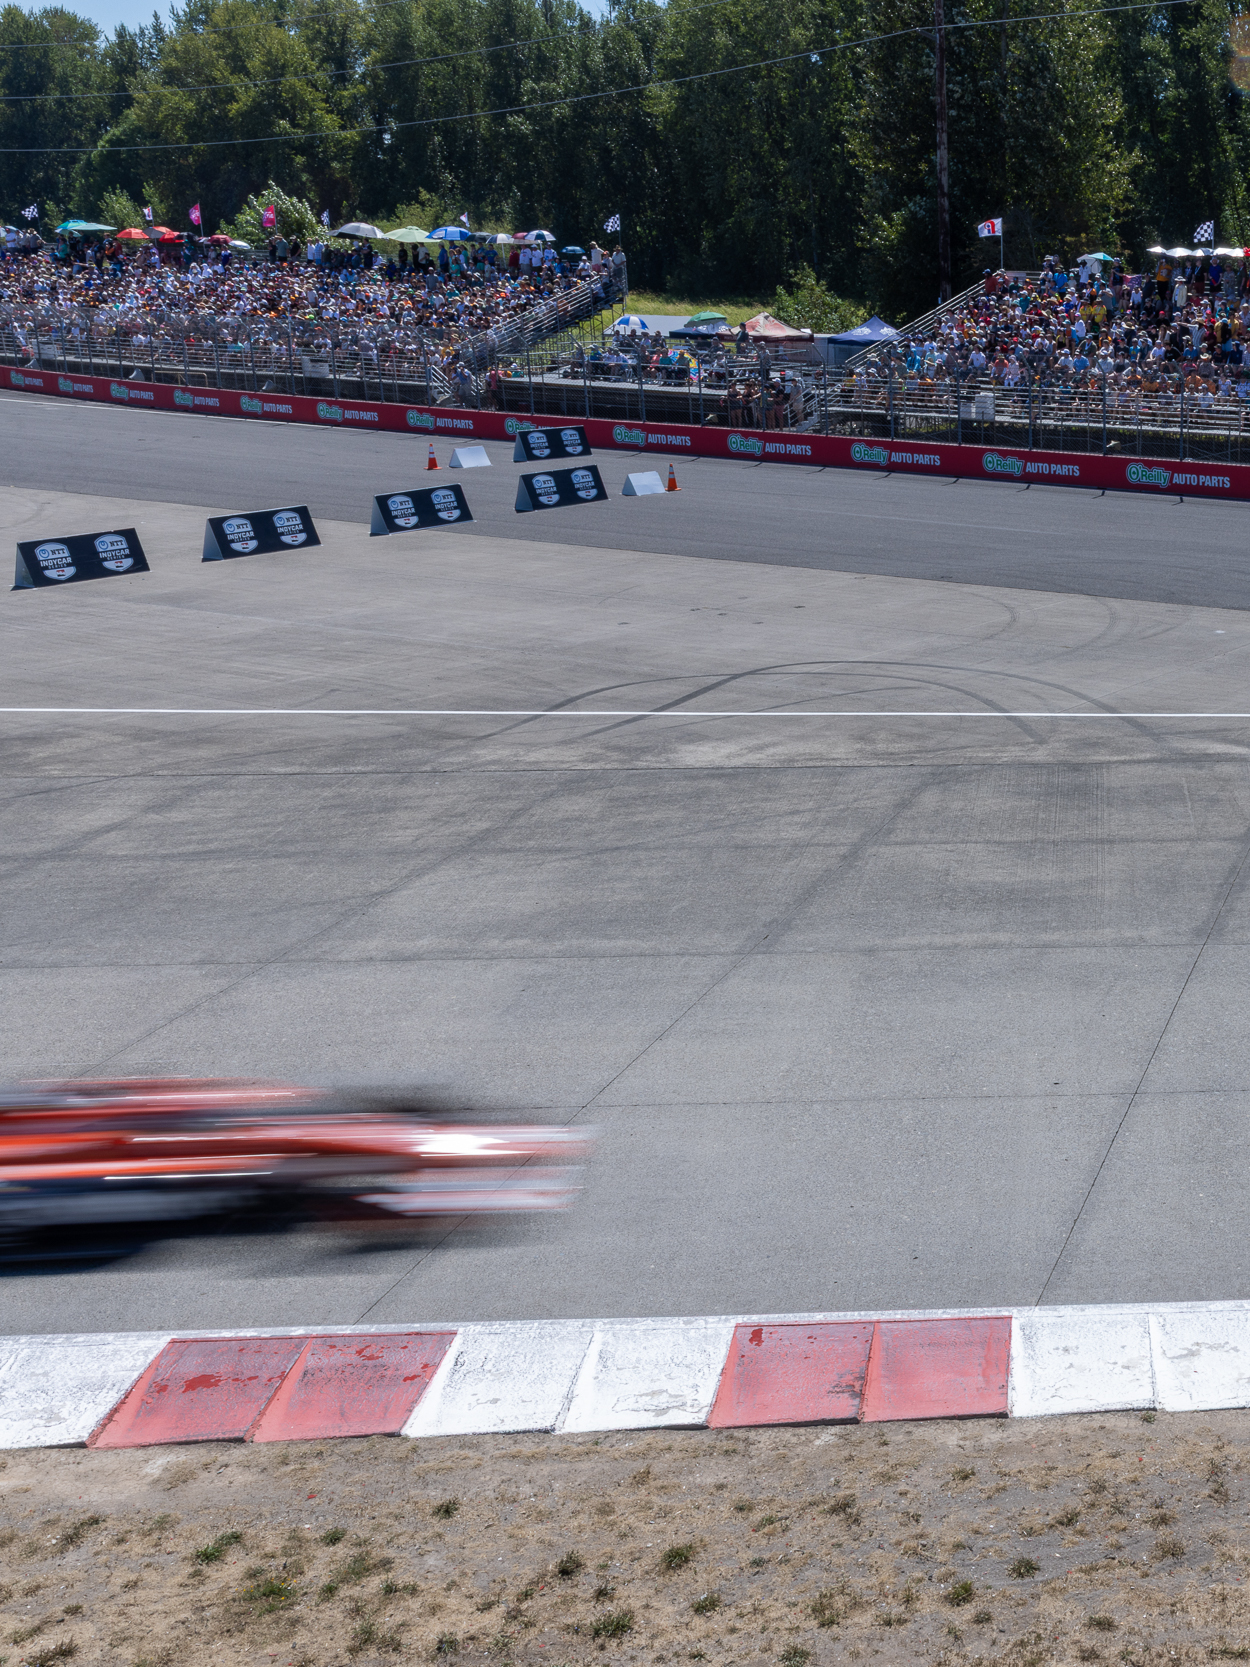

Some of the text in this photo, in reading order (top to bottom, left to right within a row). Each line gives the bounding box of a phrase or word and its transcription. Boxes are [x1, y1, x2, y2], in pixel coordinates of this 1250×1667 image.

[194, 397, 206, 405] AUTO
[206, 397, 219, 406] PARTS
[264, 403, 276, 412] AUTO
[276, 404, 292, 413] PARTS
[318, 404, 378, 421] O'Reilly AUTO PARTS
[409, 412, 473, 429] O'Reilly AUTO PARTS
[615, 427, 691, 446] O'Reilly AUTO PARTS
[730, 436, 811, 455] O'Reilly AUTO PARTS
[853, 445, 940, 465] O'Reilly AUTO PARTS
[985, 454, 1079, 476] O'Reilly AUTO PARTS
[1129, 465, 1230, 488] O'Reilly AUTO PARTS
[434, 501, 458, 510] INDYCAR
[392, 508, 416, 516] INDYCAR
[277, 524, 304, 533] INDYCAR
[227, 531, 254, 540] INDYCAR
[100, 549, 130, 558] INDYCAR
[40, 557, 72, 567] INDYCAR
